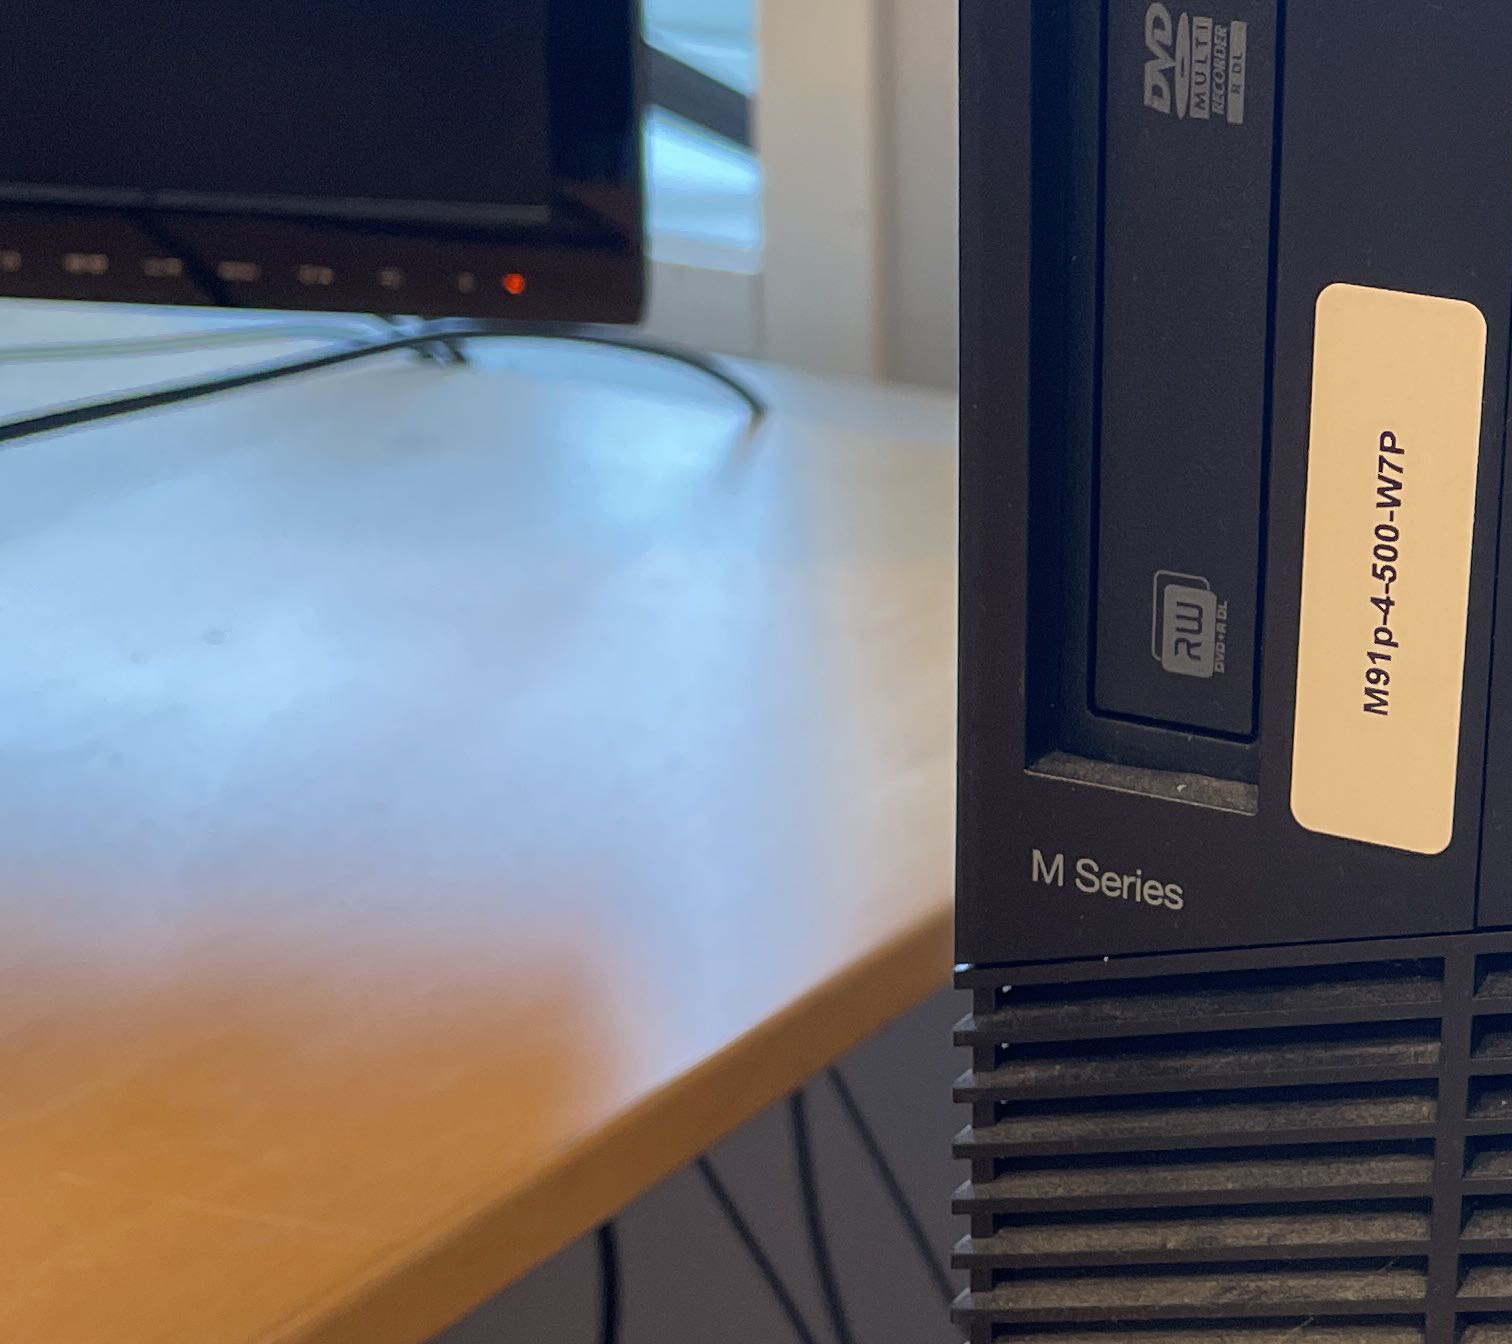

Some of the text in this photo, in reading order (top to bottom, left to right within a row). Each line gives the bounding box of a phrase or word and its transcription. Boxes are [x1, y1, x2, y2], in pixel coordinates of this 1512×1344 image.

[1143, 1, 1173, 114] DVD
[1194, 25, 1209, 111] MULTI
[1211, 24, 1228, 115] RECORDER
[1363, 430, 1405, 716] M91p-4-500-W7P
[1174, 600, 1204, 661] RW
[1031, 848, 1185, 911] M Series
